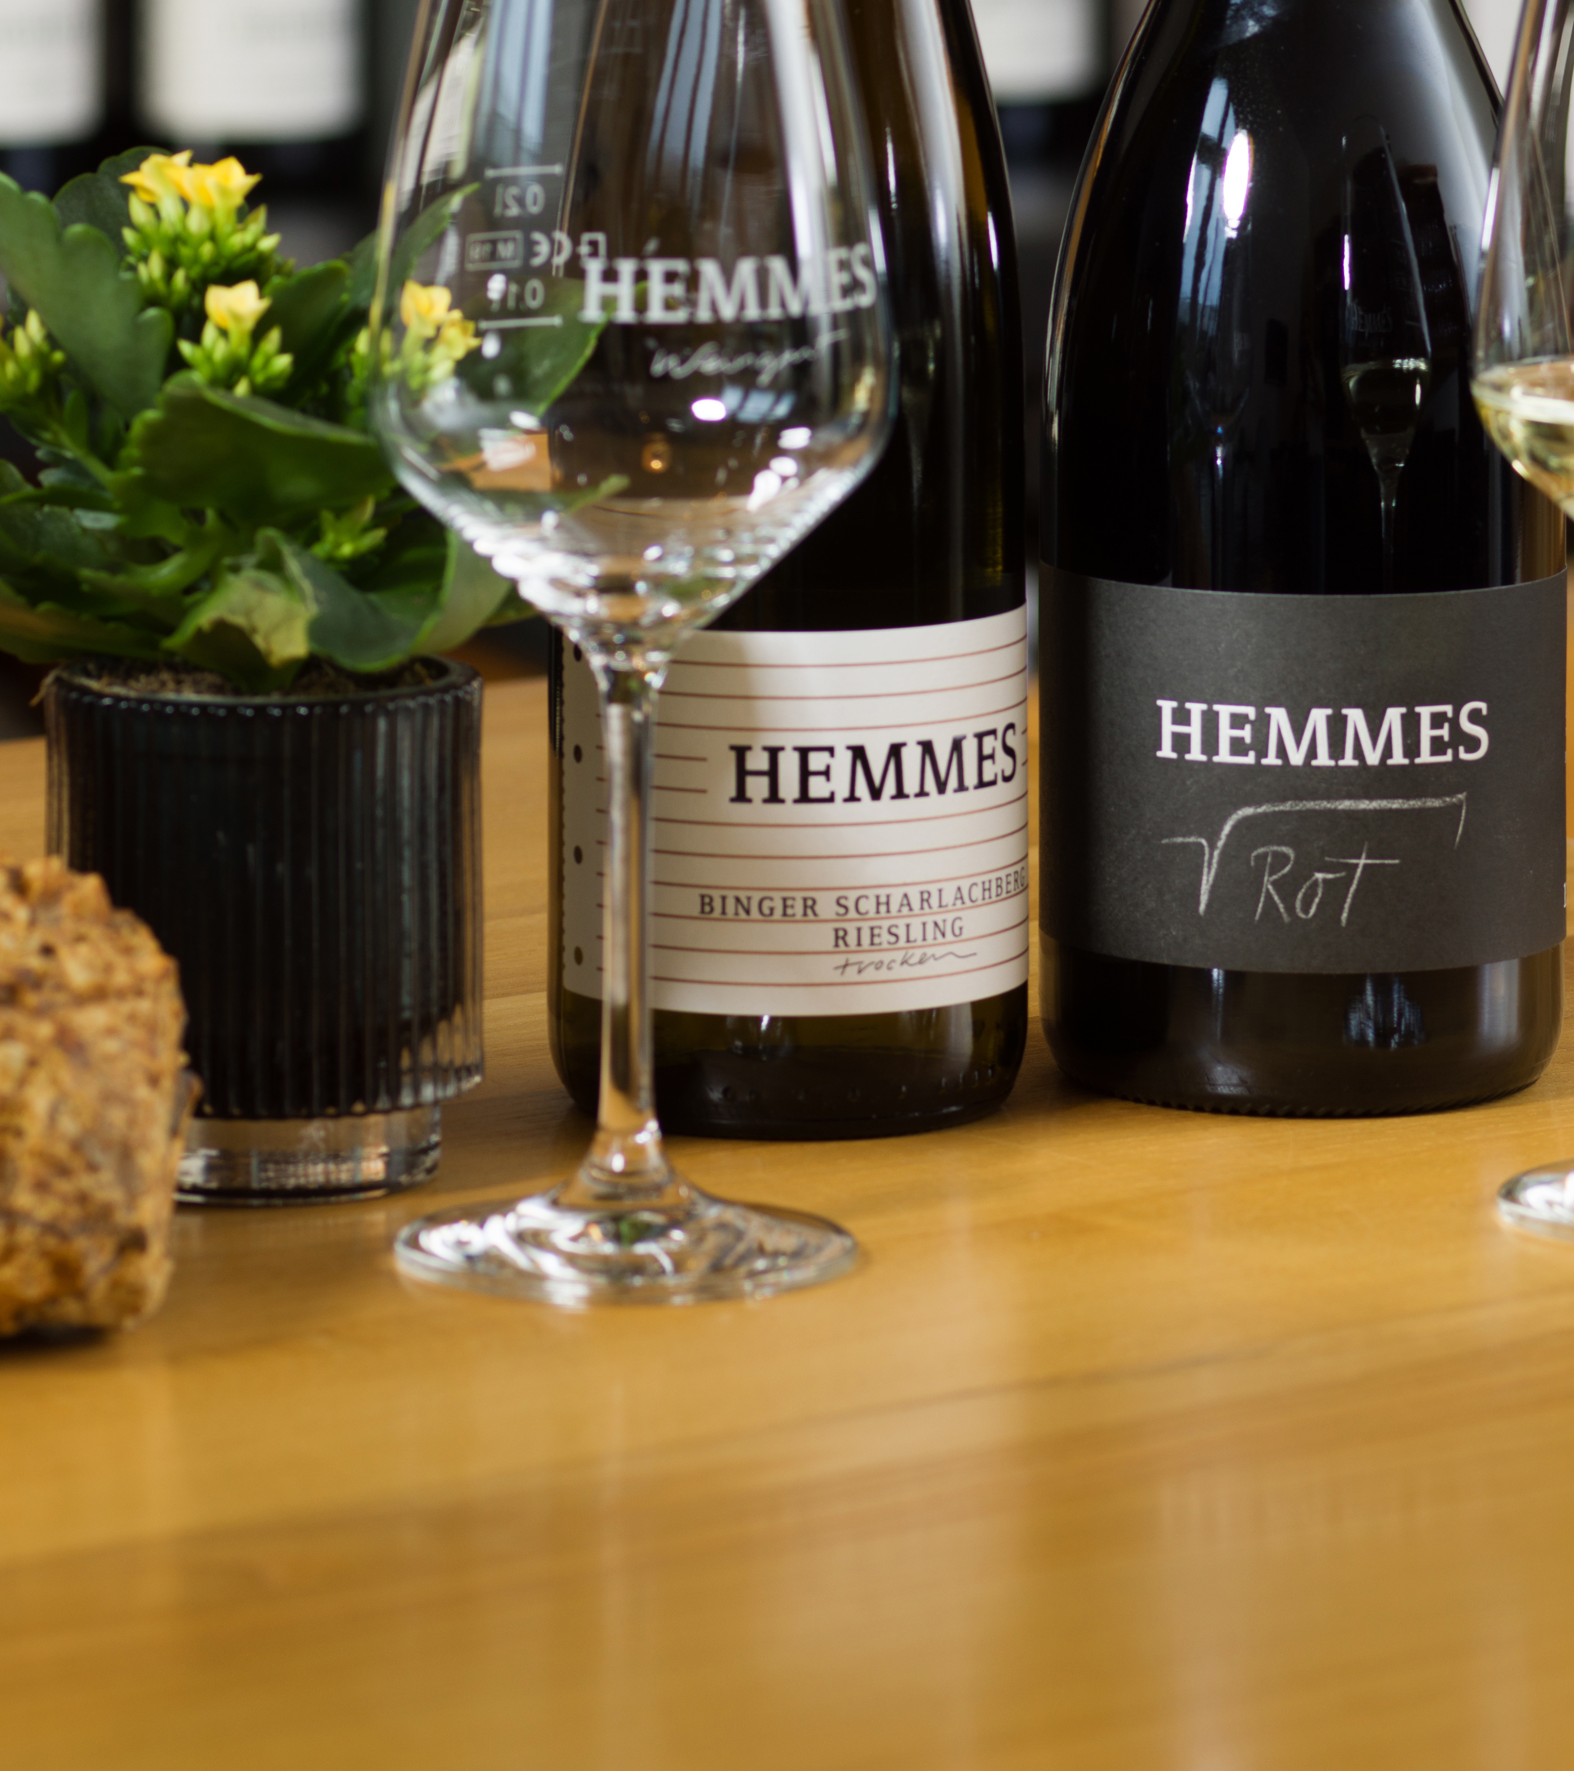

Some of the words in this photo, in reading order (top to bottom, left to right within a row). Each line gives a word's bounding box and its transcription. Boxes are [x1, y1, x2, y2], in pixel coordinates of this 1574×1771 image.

[578, 241, 878, 324] HEMMES
[1156, 699, 1490, 766] HEMMES
[728, 722, 1018, 804] HEMMES
[698, 892, 820, 918] BINGER
[834, 866, 1026, 917] SCHARLACHBERG
[832, 917, 965, 949] RIESLING
[833, 950, 978, 976] trocken
